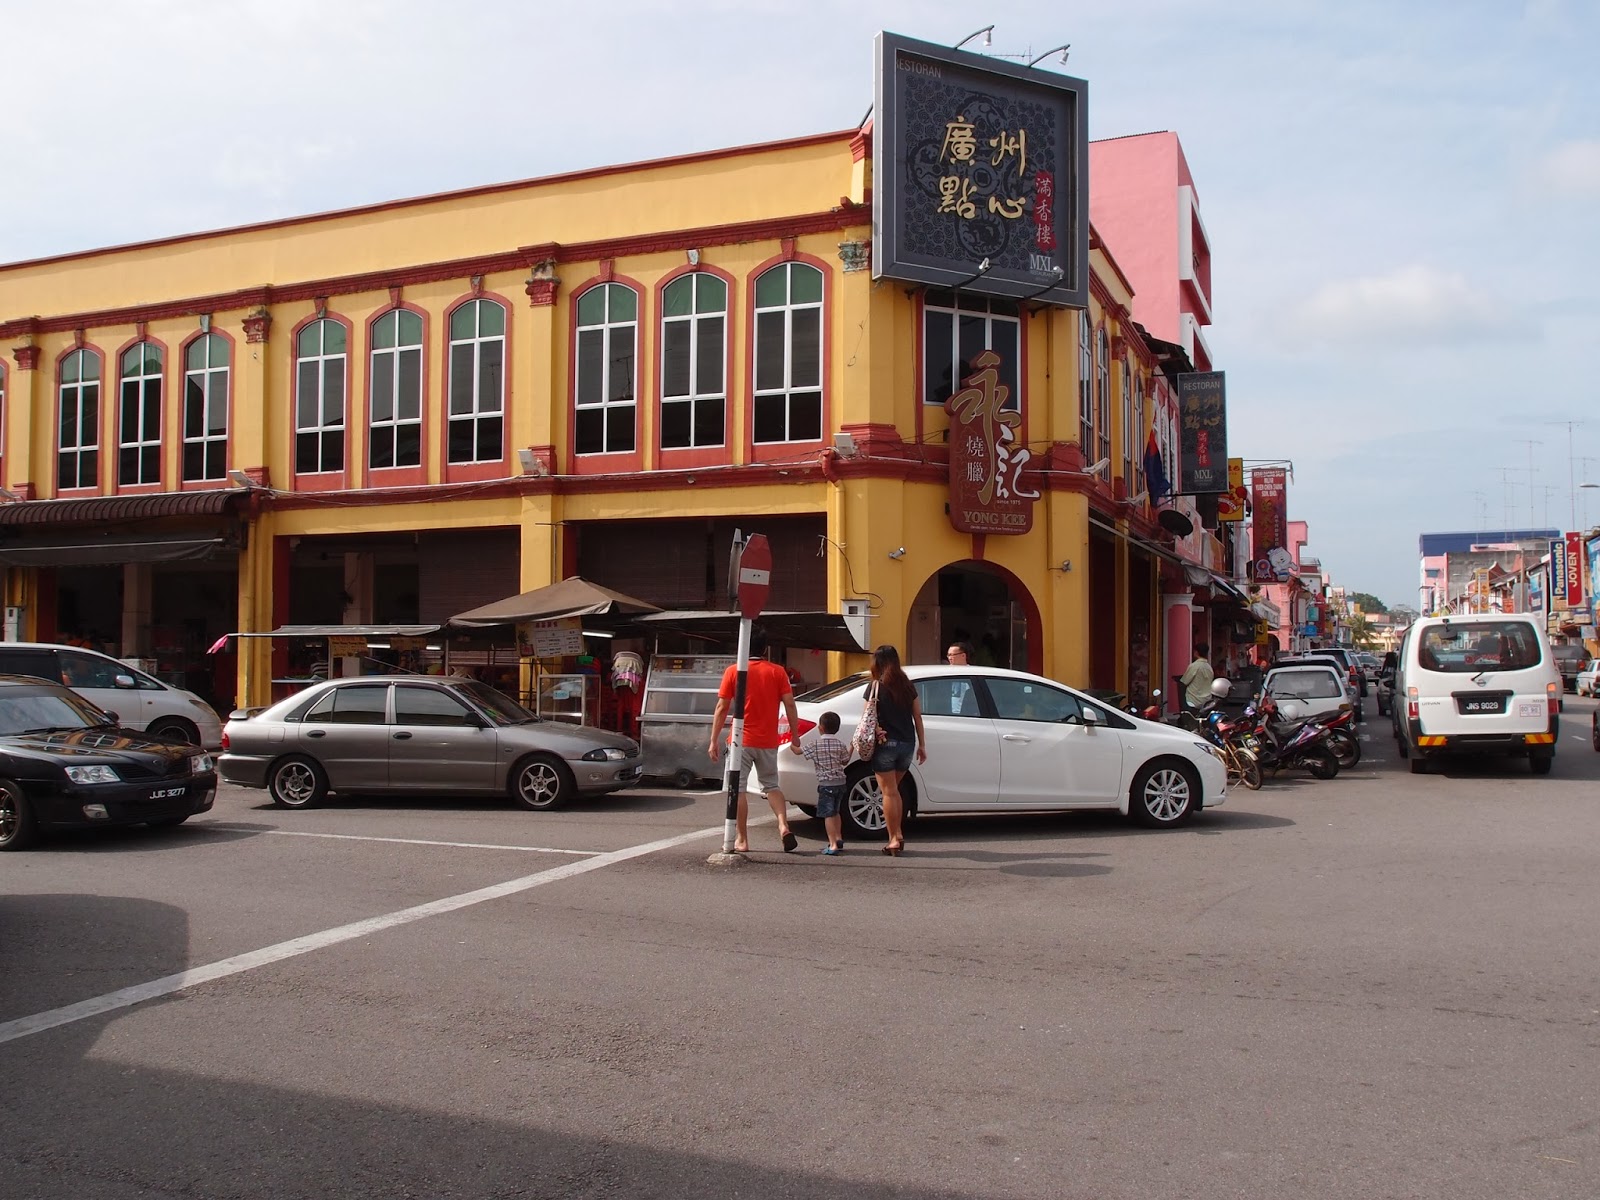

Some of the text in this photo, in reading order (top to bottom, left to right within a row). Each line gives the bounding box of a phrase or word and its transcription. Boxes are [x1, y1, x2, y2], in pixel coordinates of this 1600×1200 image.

[939, 115, 1026, 177] 廣州
[937, 176, 1026, 219] 點心
[1183, 381, 1221, 391] RESTORAN
[1194, 469, 1213, 480] MXL
[963, 510, 1027, 526] YONG KEE
[1554, 542, 1565, 595] Panasonic
[1568, 551, 1578, 588] JOVEN
[1481, 702, 1499, 710] 9029
[149, 787, 186, 799] JJC 3277
